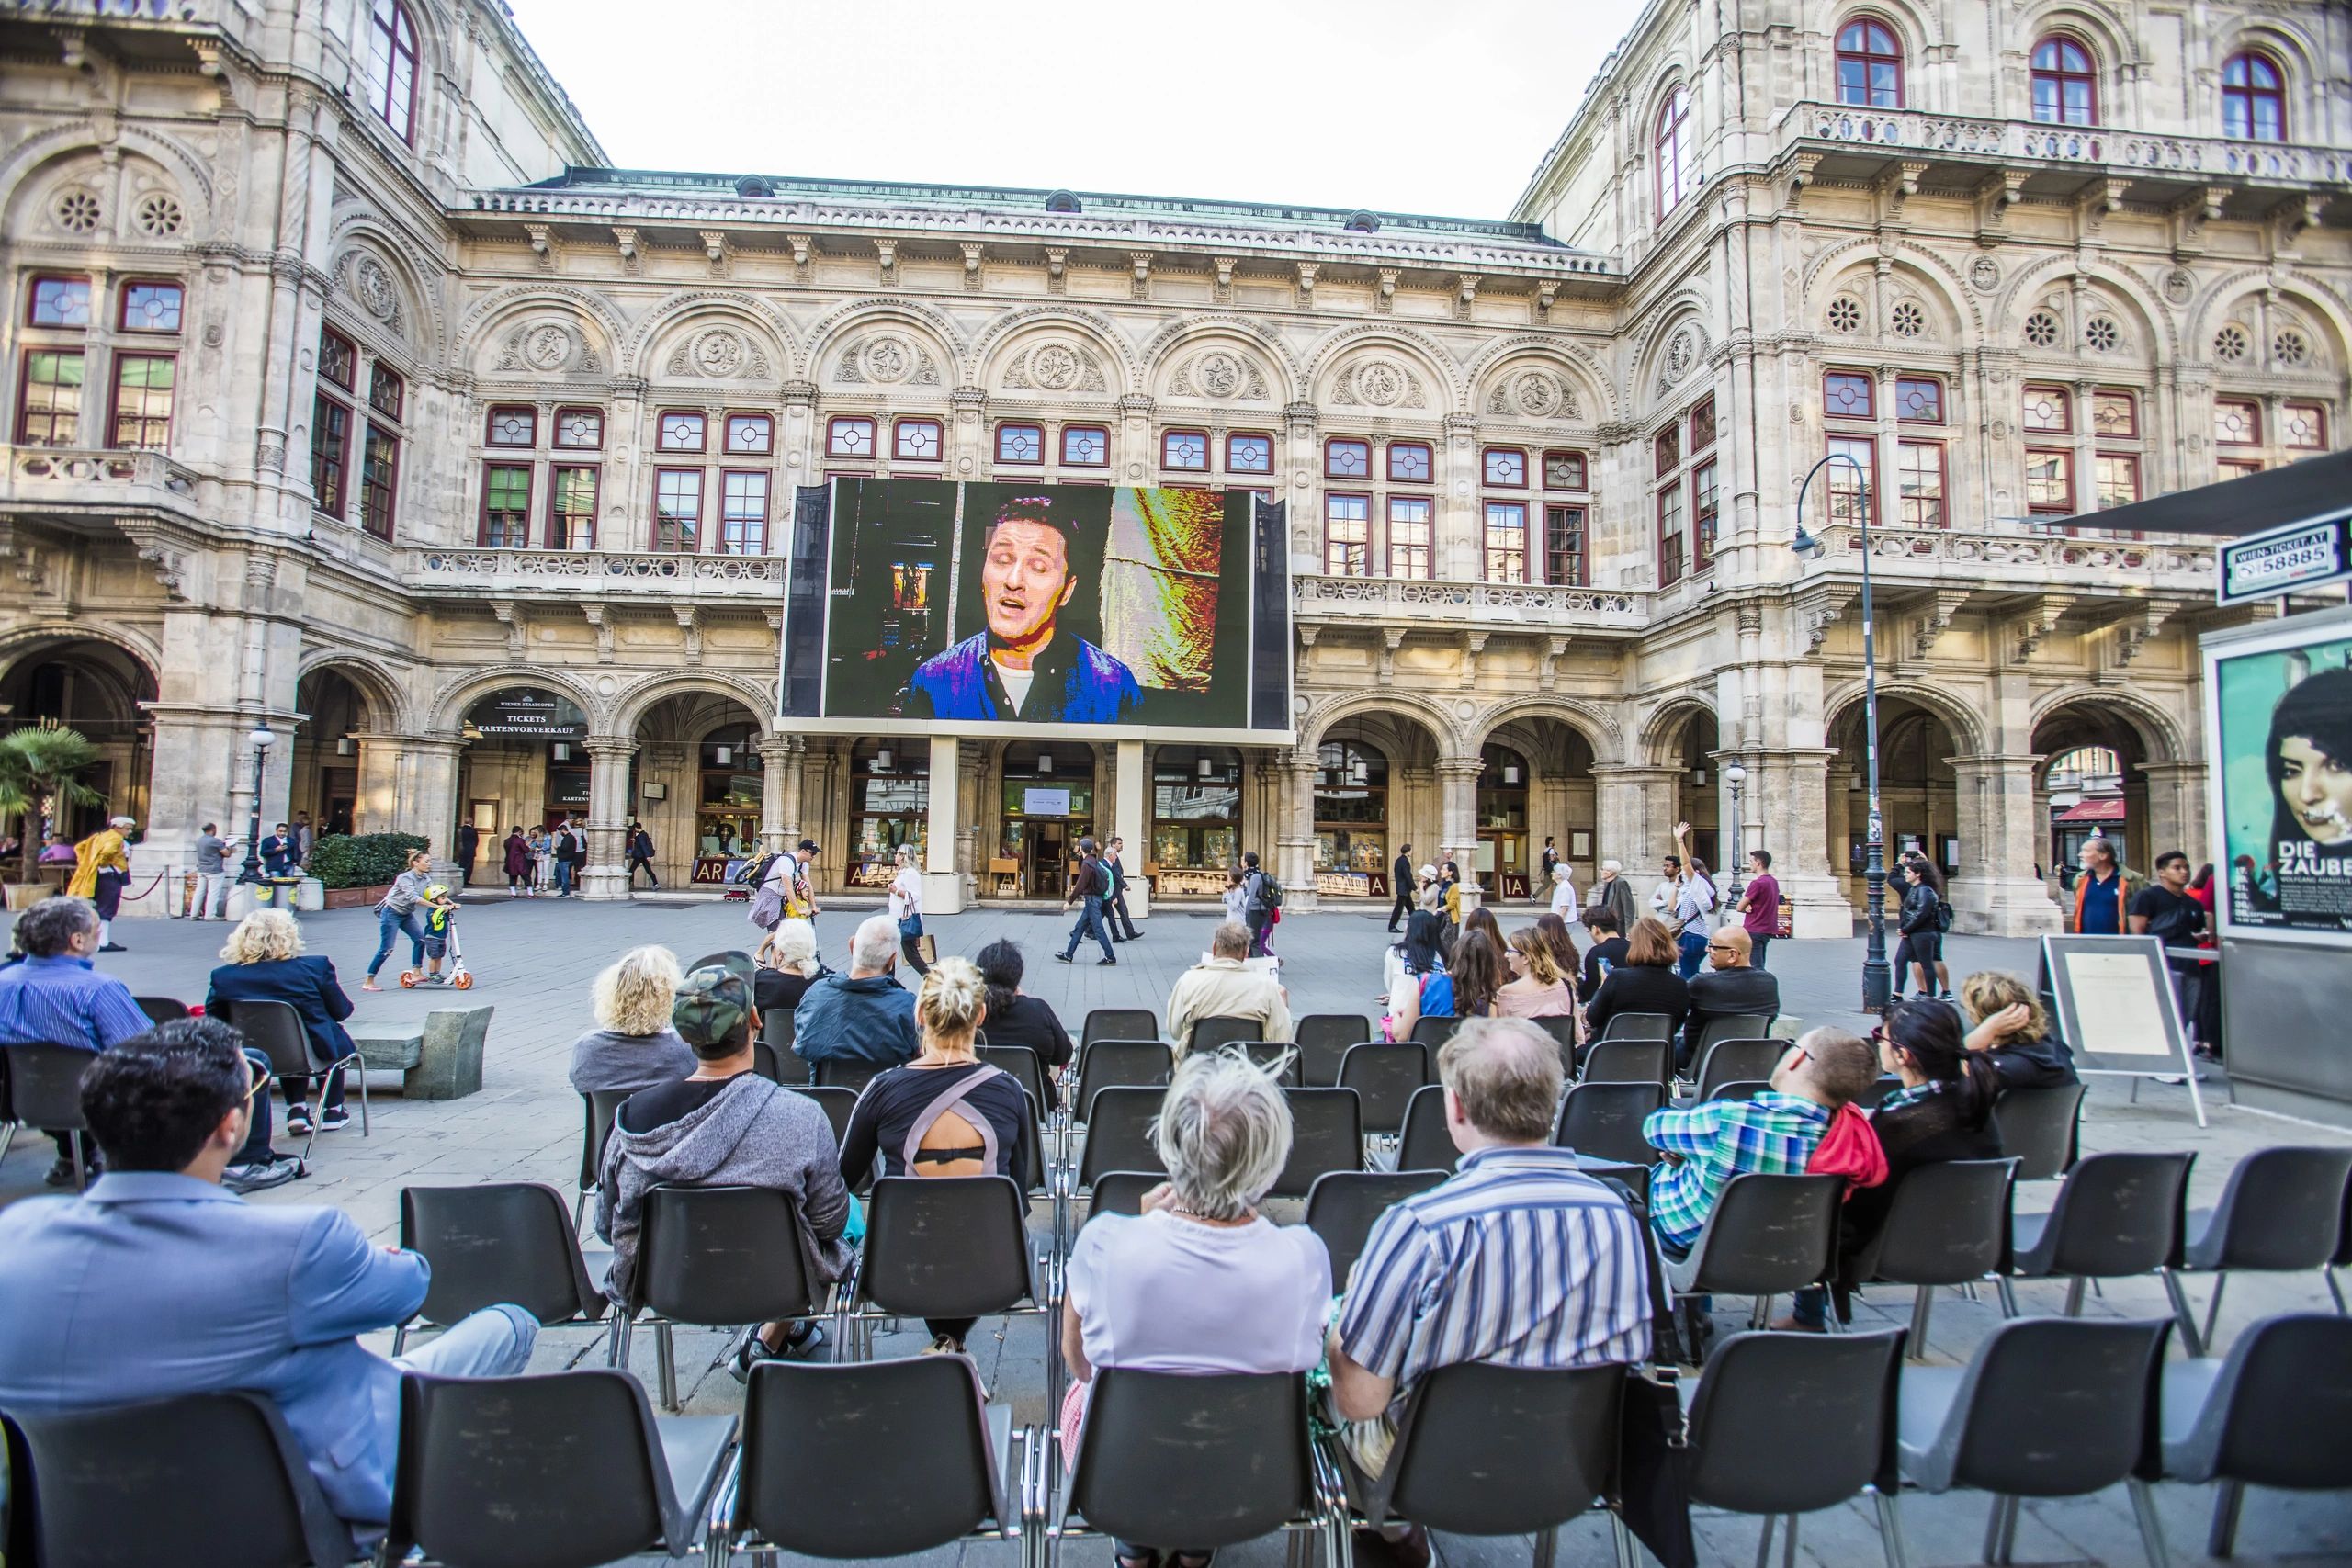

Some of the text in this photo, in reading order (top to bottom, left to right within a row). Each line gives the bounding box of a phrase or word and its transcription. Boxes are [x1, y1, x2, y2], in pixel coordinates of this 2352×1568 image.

[2263, 546, 2325, 573] 58885
[478, 725, 575, 734] KARTENVORVERKAUF
[2278, 841, 2316, 858] DIE
[2278, 858, 2352, 876] ZAUBE
